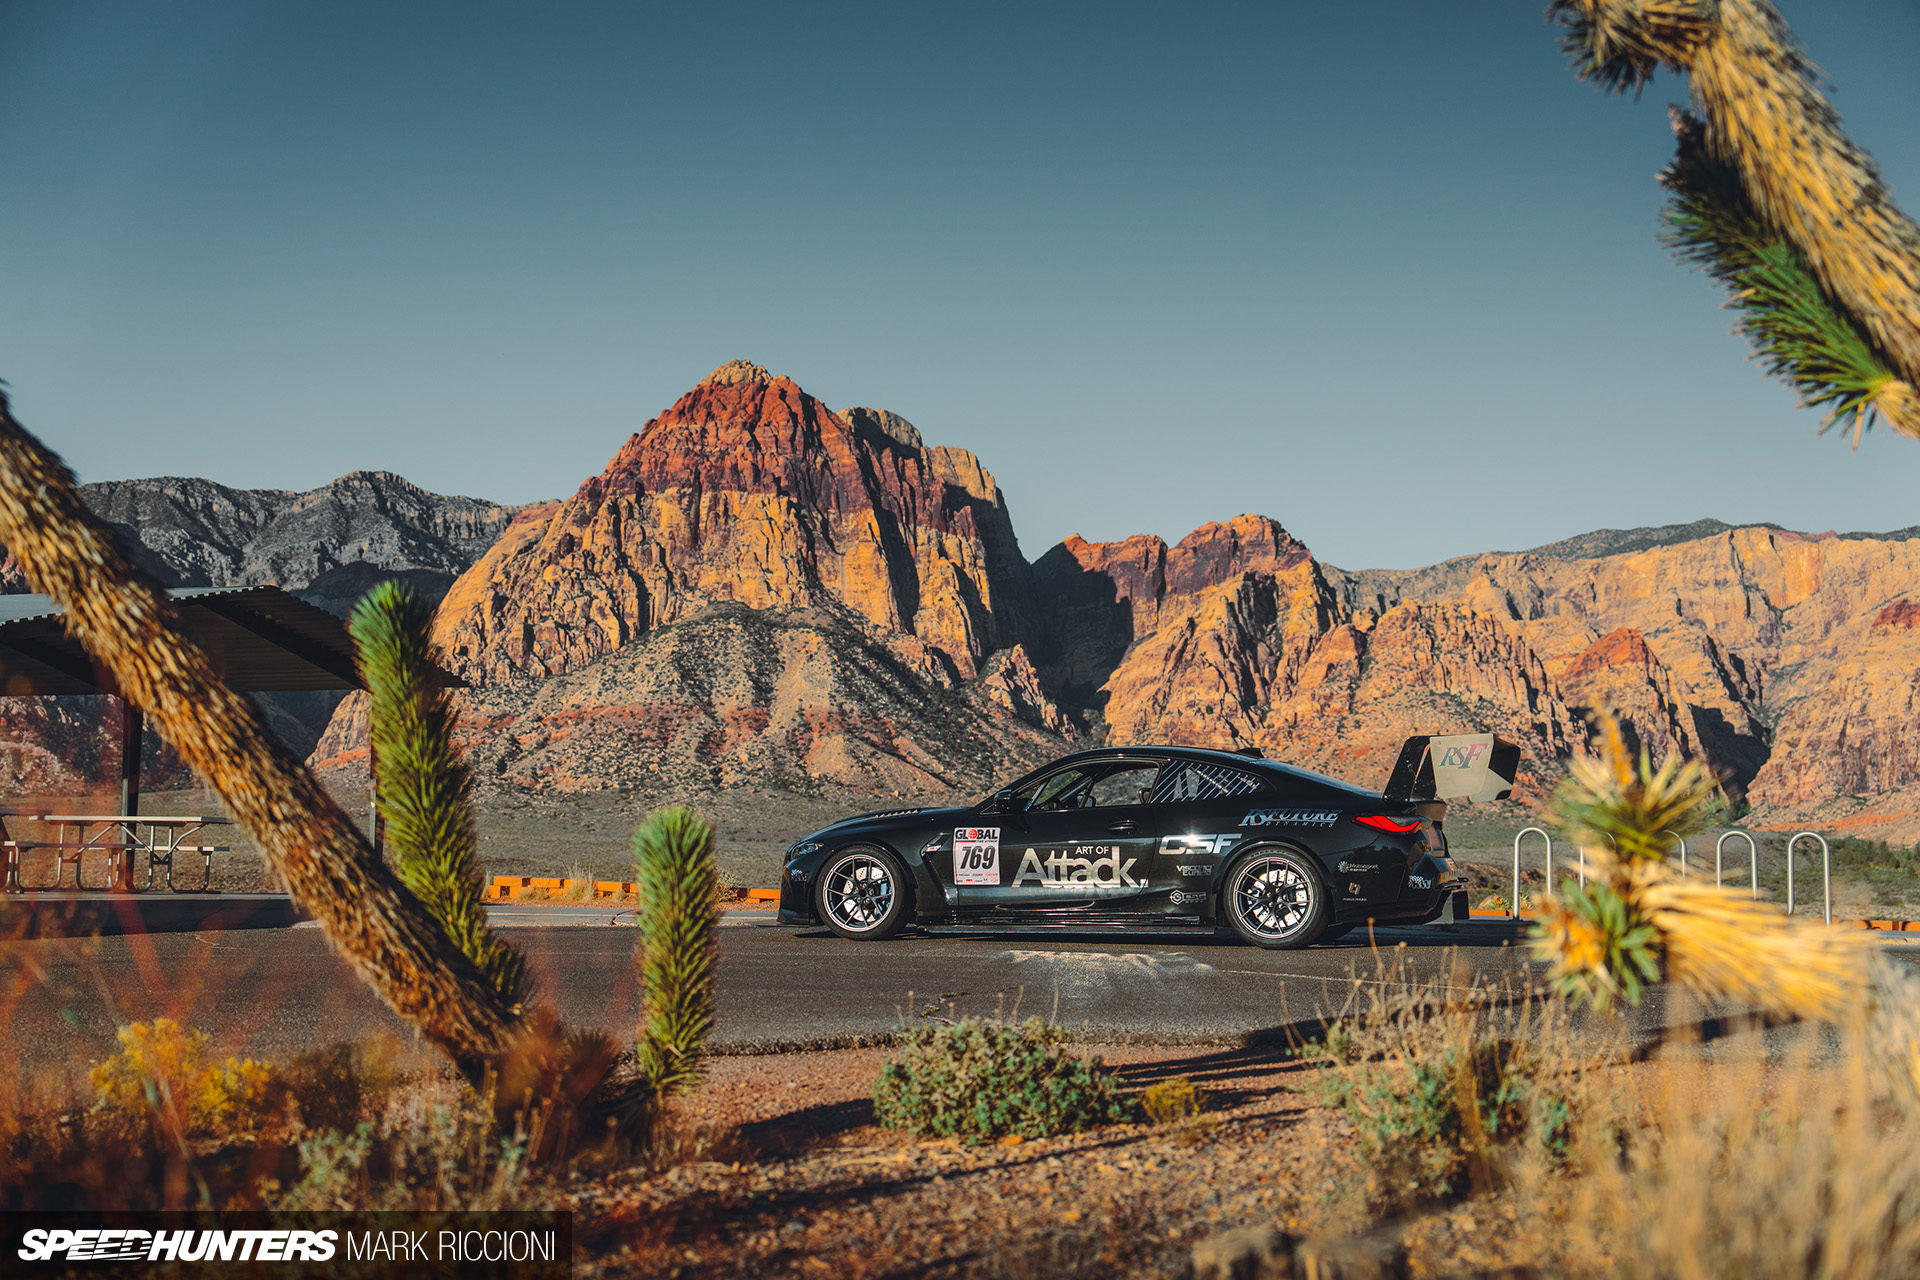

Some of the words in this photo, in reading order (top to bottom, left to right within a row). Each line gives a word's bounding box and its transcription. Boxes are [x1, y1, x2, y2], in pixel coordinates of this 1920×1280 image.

[1438, 743, 1489, 769] RSF
[955, 828, 998, 840] GLOBAL
[1158, 833, 1243, 855] CSF
[960, 845, 996, 870] 769
[1075, 846, 1093, 855] ART
[1096, 846, 1109, 855] OF
